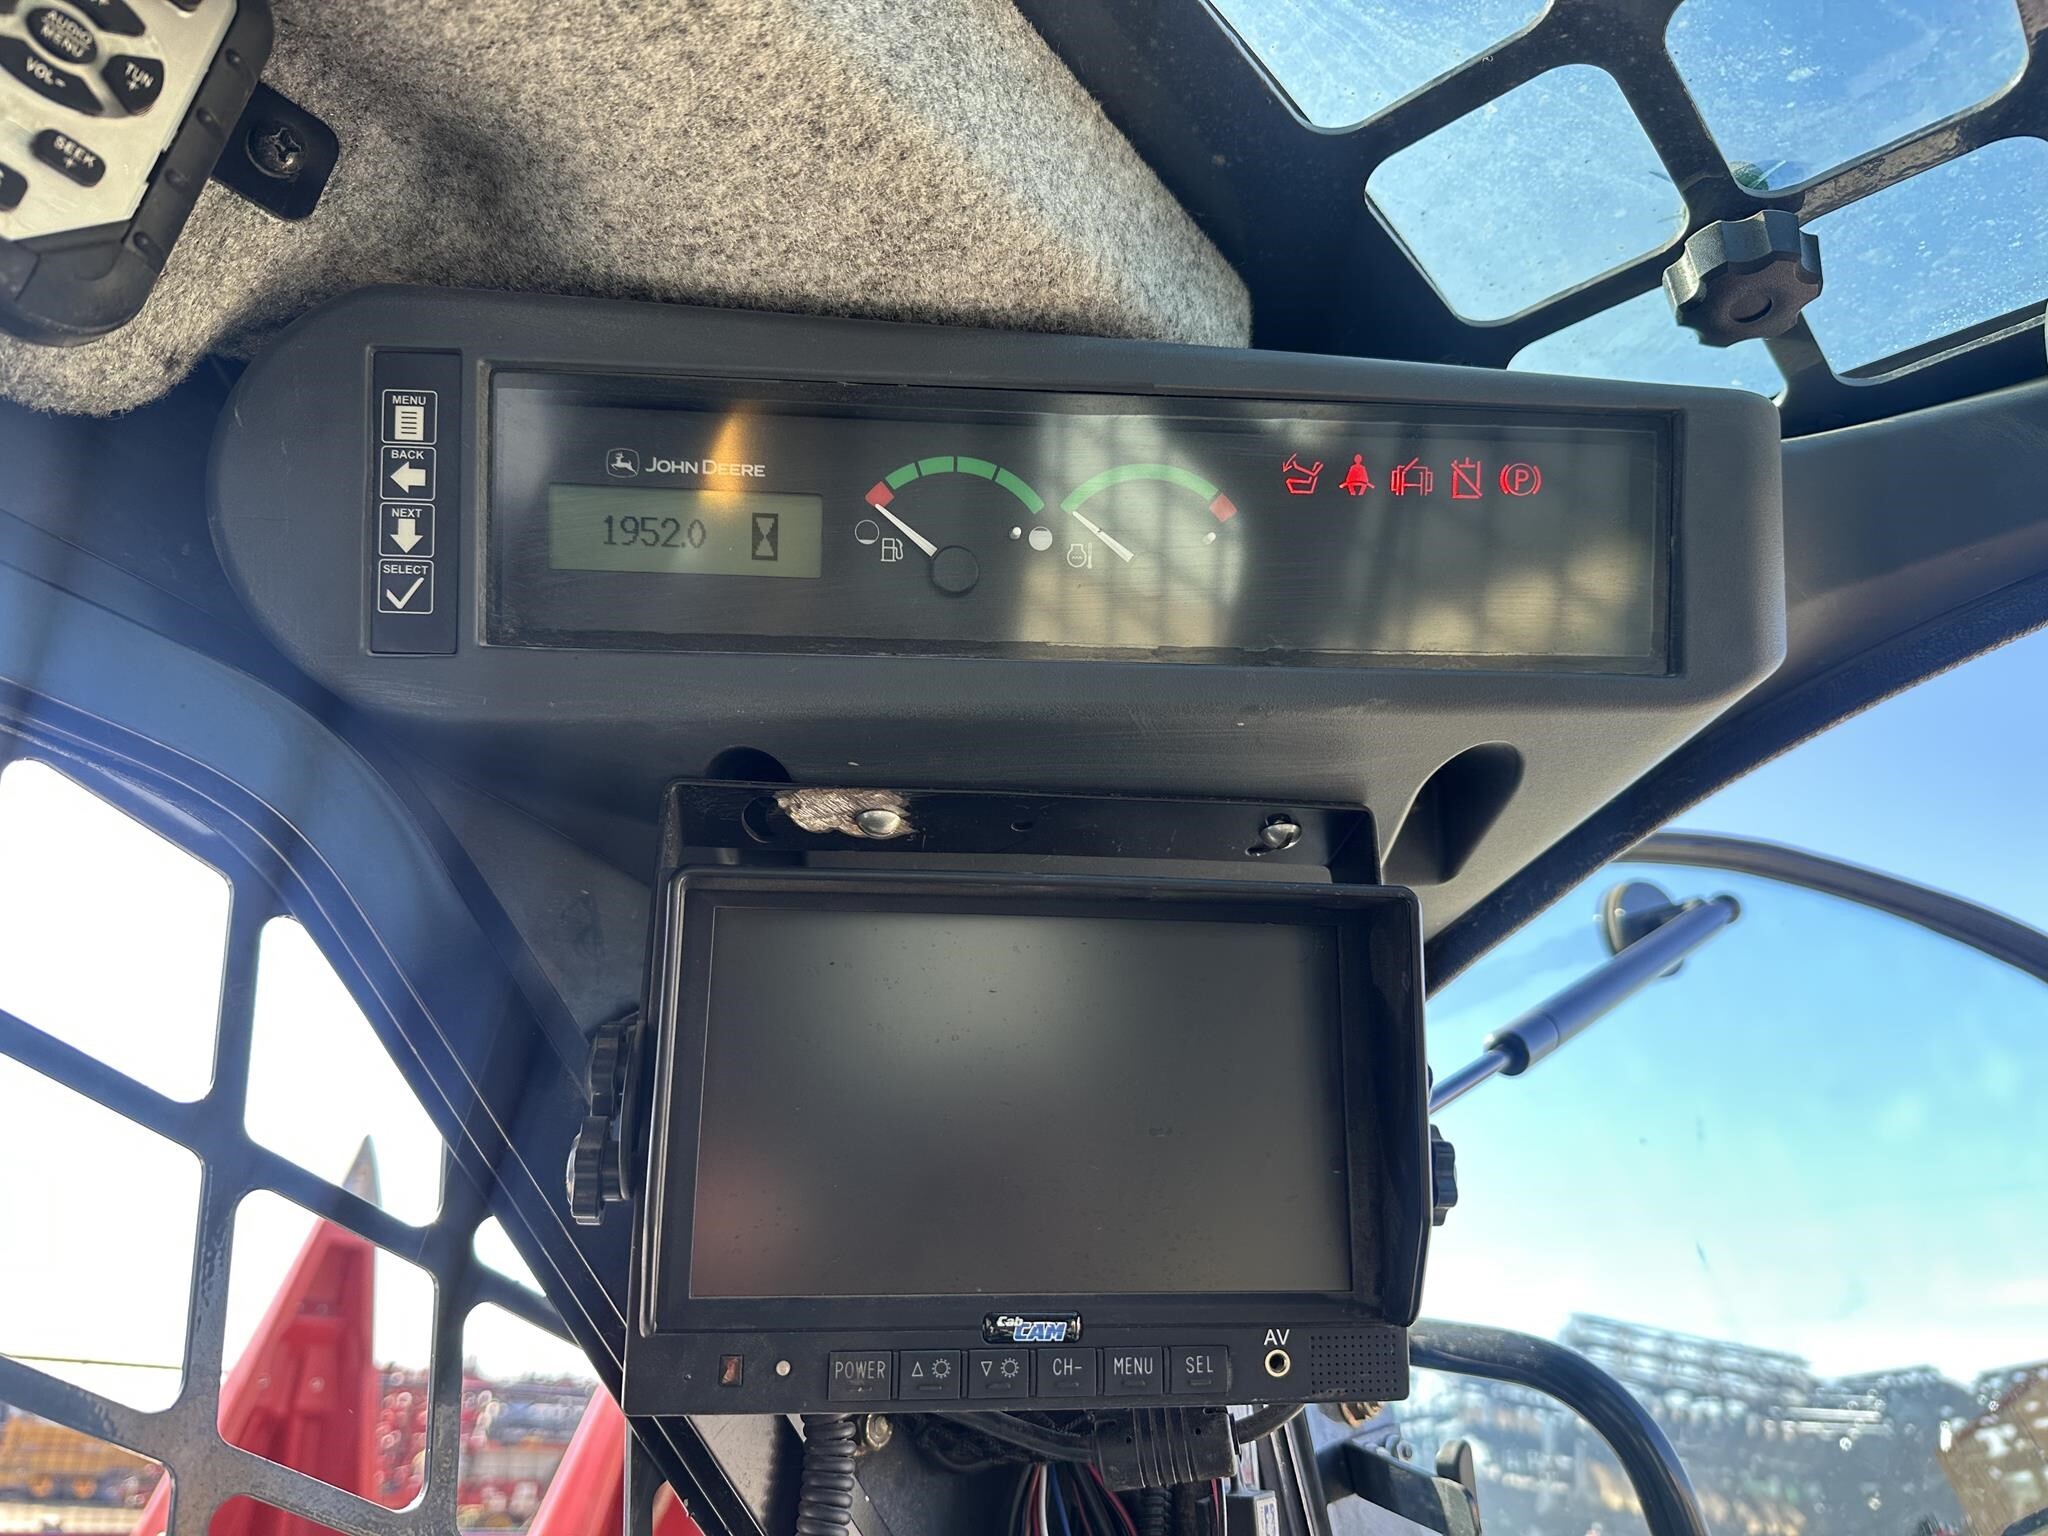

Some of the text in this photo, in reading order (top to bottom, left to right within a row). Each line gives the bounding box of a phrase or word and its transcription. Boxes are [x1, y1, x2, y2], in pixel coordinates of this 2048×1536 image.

[41, 10, 94, 45] AUDIO
[40, 24, 84, 58] MENU
[124, 61, 155, 89] TUN
[54, 135, 97, 169] SEEK
[392, 395, 427, 406] MENU
[391, 449, 425, 460] BACK
[391, 508, 423, 518] NEXT
[602, 514, 707, 549] 1952.0
[382, 564, 429, 575] SELECT
[996, 1315, 1024, 1327] Cab
[1013, 1321, 1067, 1342] CAM
[1263, 1328, 1290, 1347] AV
[834, 1360, 886, 1380] POWER
[1052, 1357, 1083, 1377] CH-
[1113, 1356, 1154, 1376] MENU
[1185, 1355, 1214, 1375] SEL
